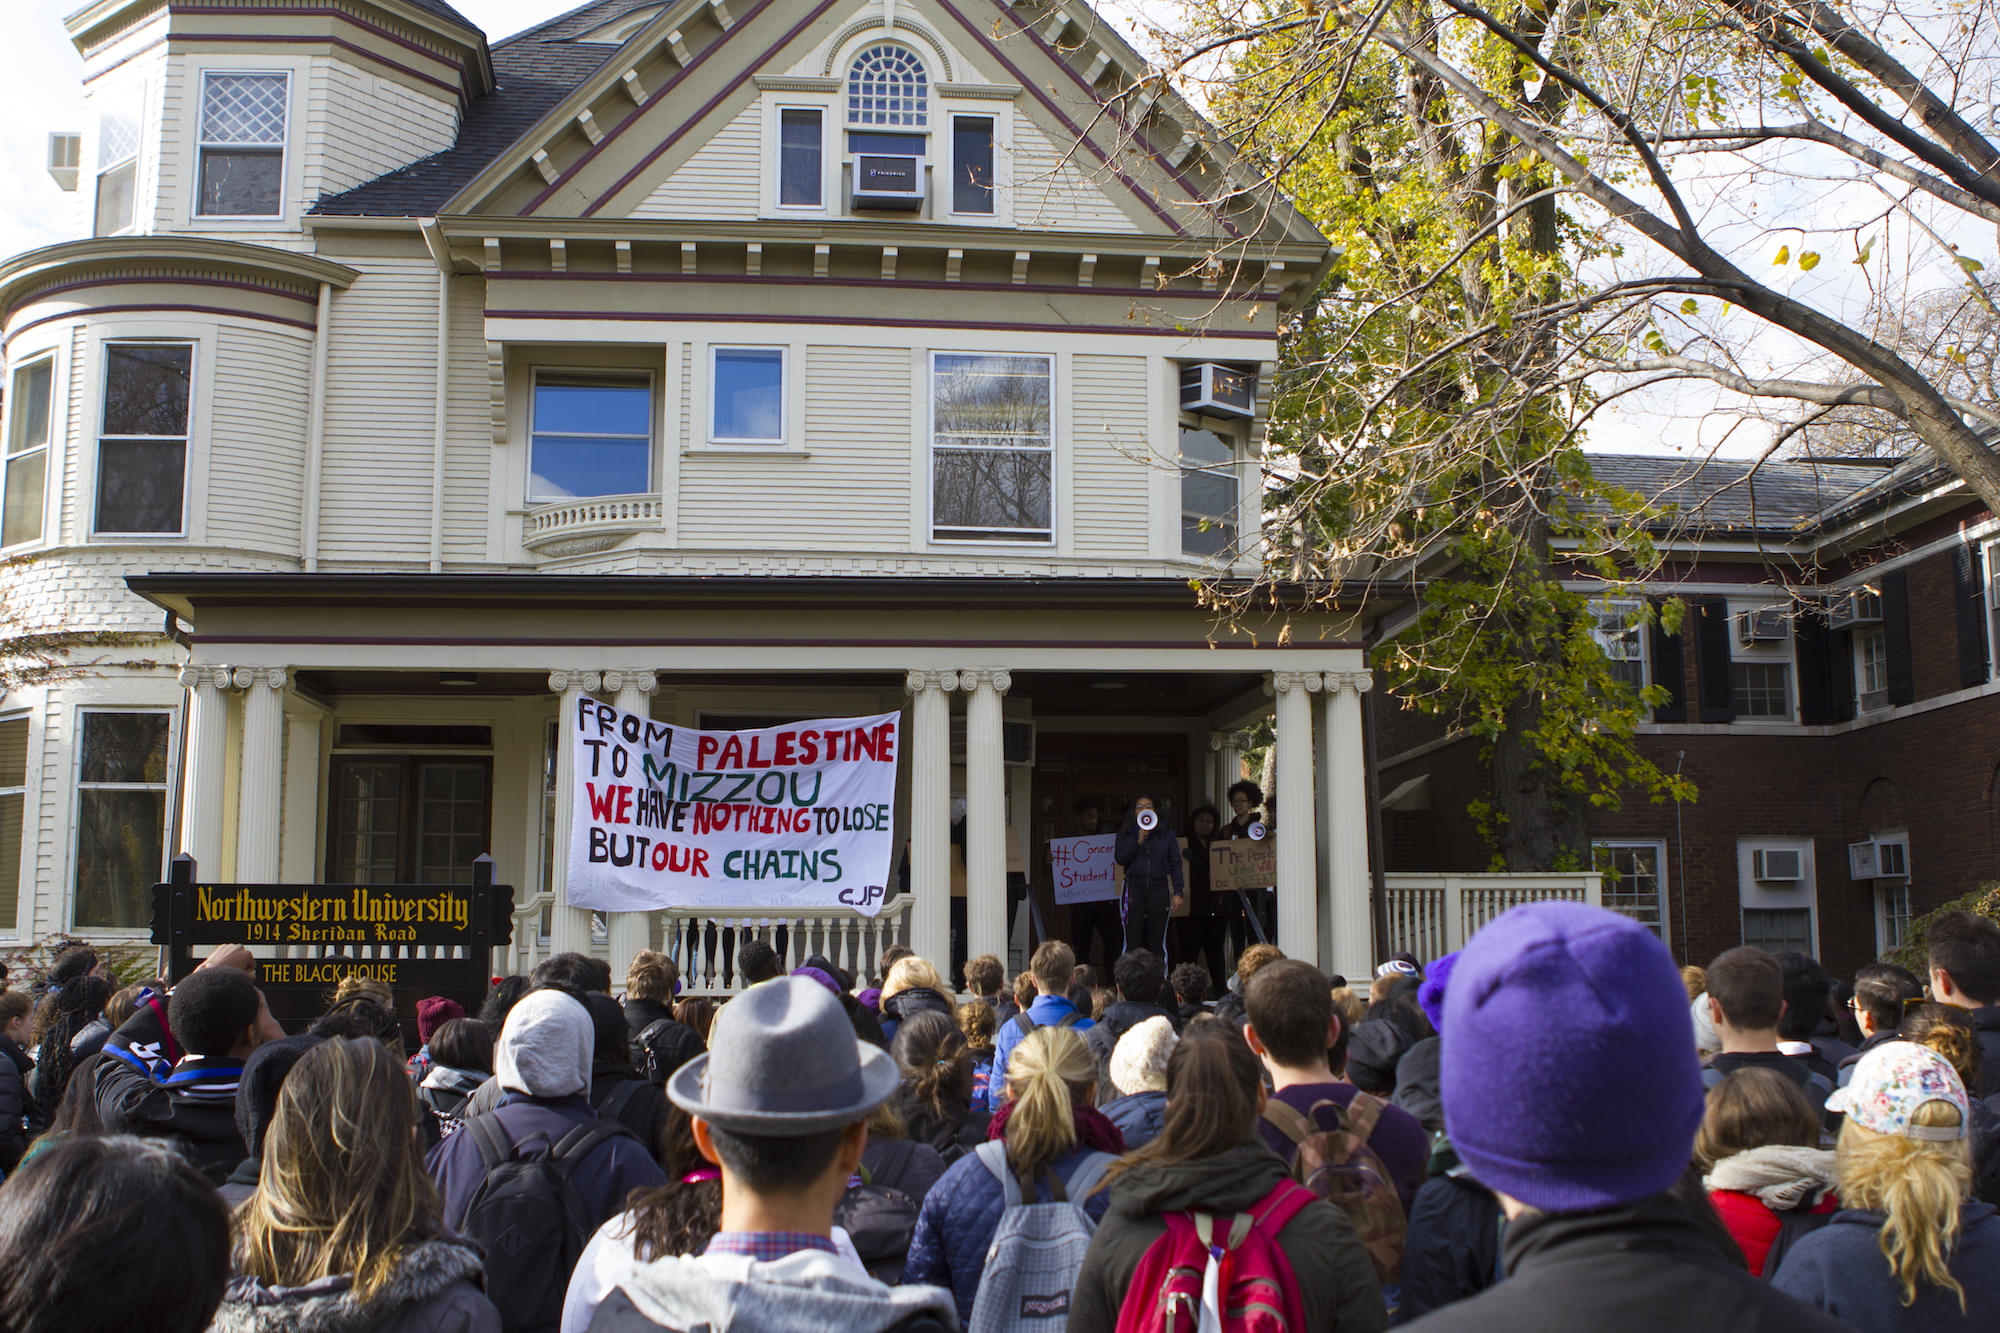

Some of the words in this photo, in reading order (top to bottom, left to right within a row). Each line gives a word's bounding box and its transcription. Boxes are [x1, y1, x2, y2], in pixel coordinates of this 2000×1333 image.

[579, 698, 673, 757] FROM
[697, 723, 894, 771] PALESTINE
[583, 739, 629, 778] TO
[643, 753, 822, 807] MIZZOU
[586, 782, 633, 824] WE
[637, 788, 691, 832] HAVE
[693, 802, 811, 835] NOTHING
[813, 807, 840, 835] TO
[843, 804, 889, 831] LOSE
[589, 827, 650, 868] BUT
[652, 842, 710, 878] OUR
[723, 849, 842, 883] CHAINS
[1052, 840, 1114, 867] #Concer
[1212, 847, 1244, 865] The
[196, 886, 347, 921] Northwestern
[352, 888, 468, 931] University
[838, 886, 884, 906] CJP
[247, 923, 280, 941] 1914
[286, 922, 365, 941] Sheridan
[374, 923, 417, 941] Road
[262, 964, 290, 983] THE
[295, 964, 342, 983] BLACK
[347, 964, 397, 983] HOUSE
